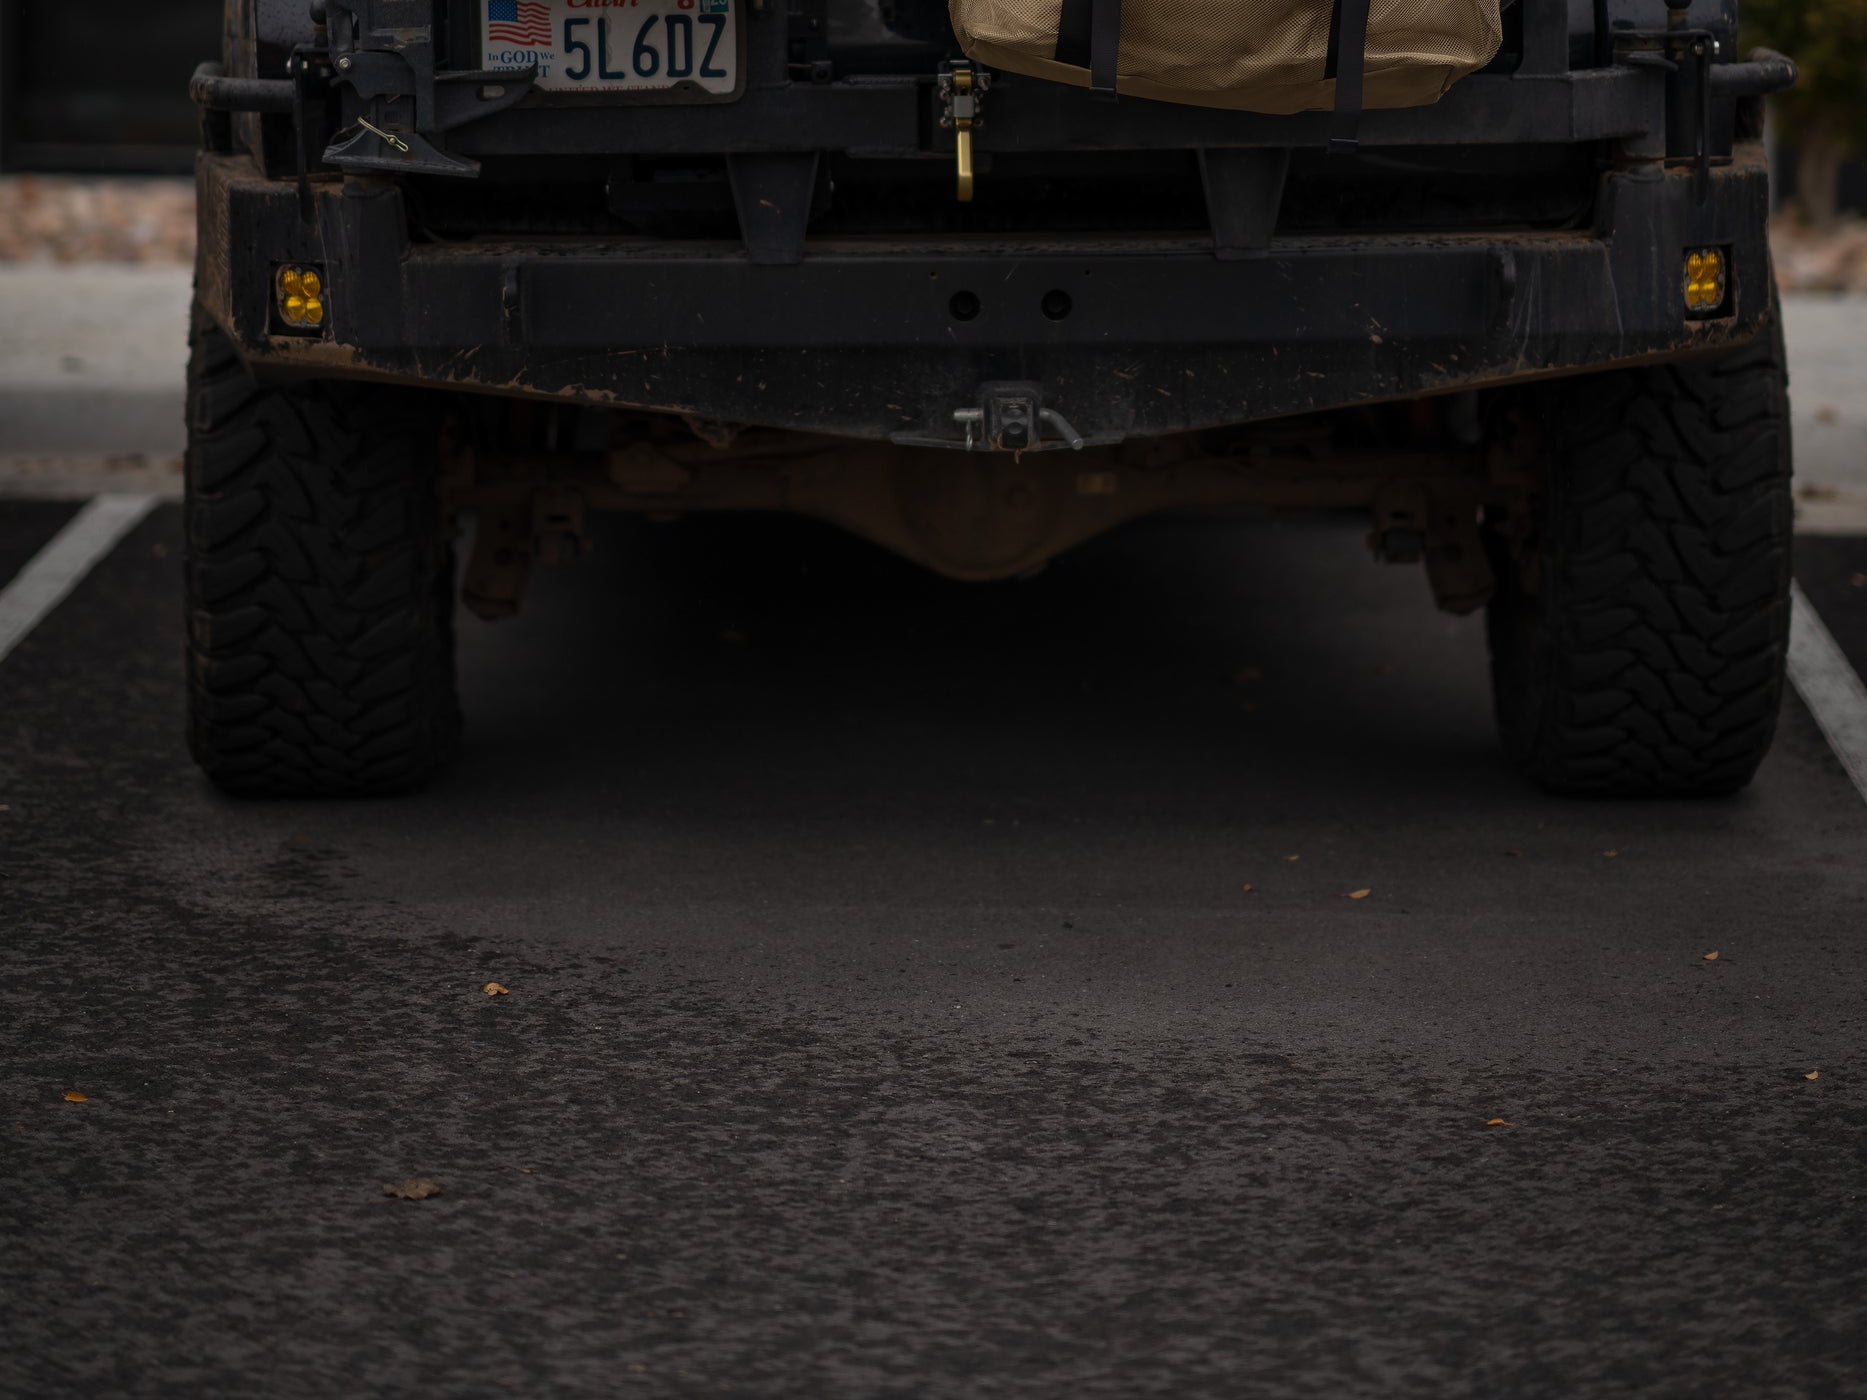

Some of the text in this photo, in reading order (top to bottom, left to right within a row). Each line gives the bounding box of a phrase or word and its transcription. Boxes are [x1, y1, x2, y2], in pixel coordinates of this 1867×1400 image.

[488, 50, 555, 64] In GOD We
[564, 13, 727, 80] 5L6DZ
